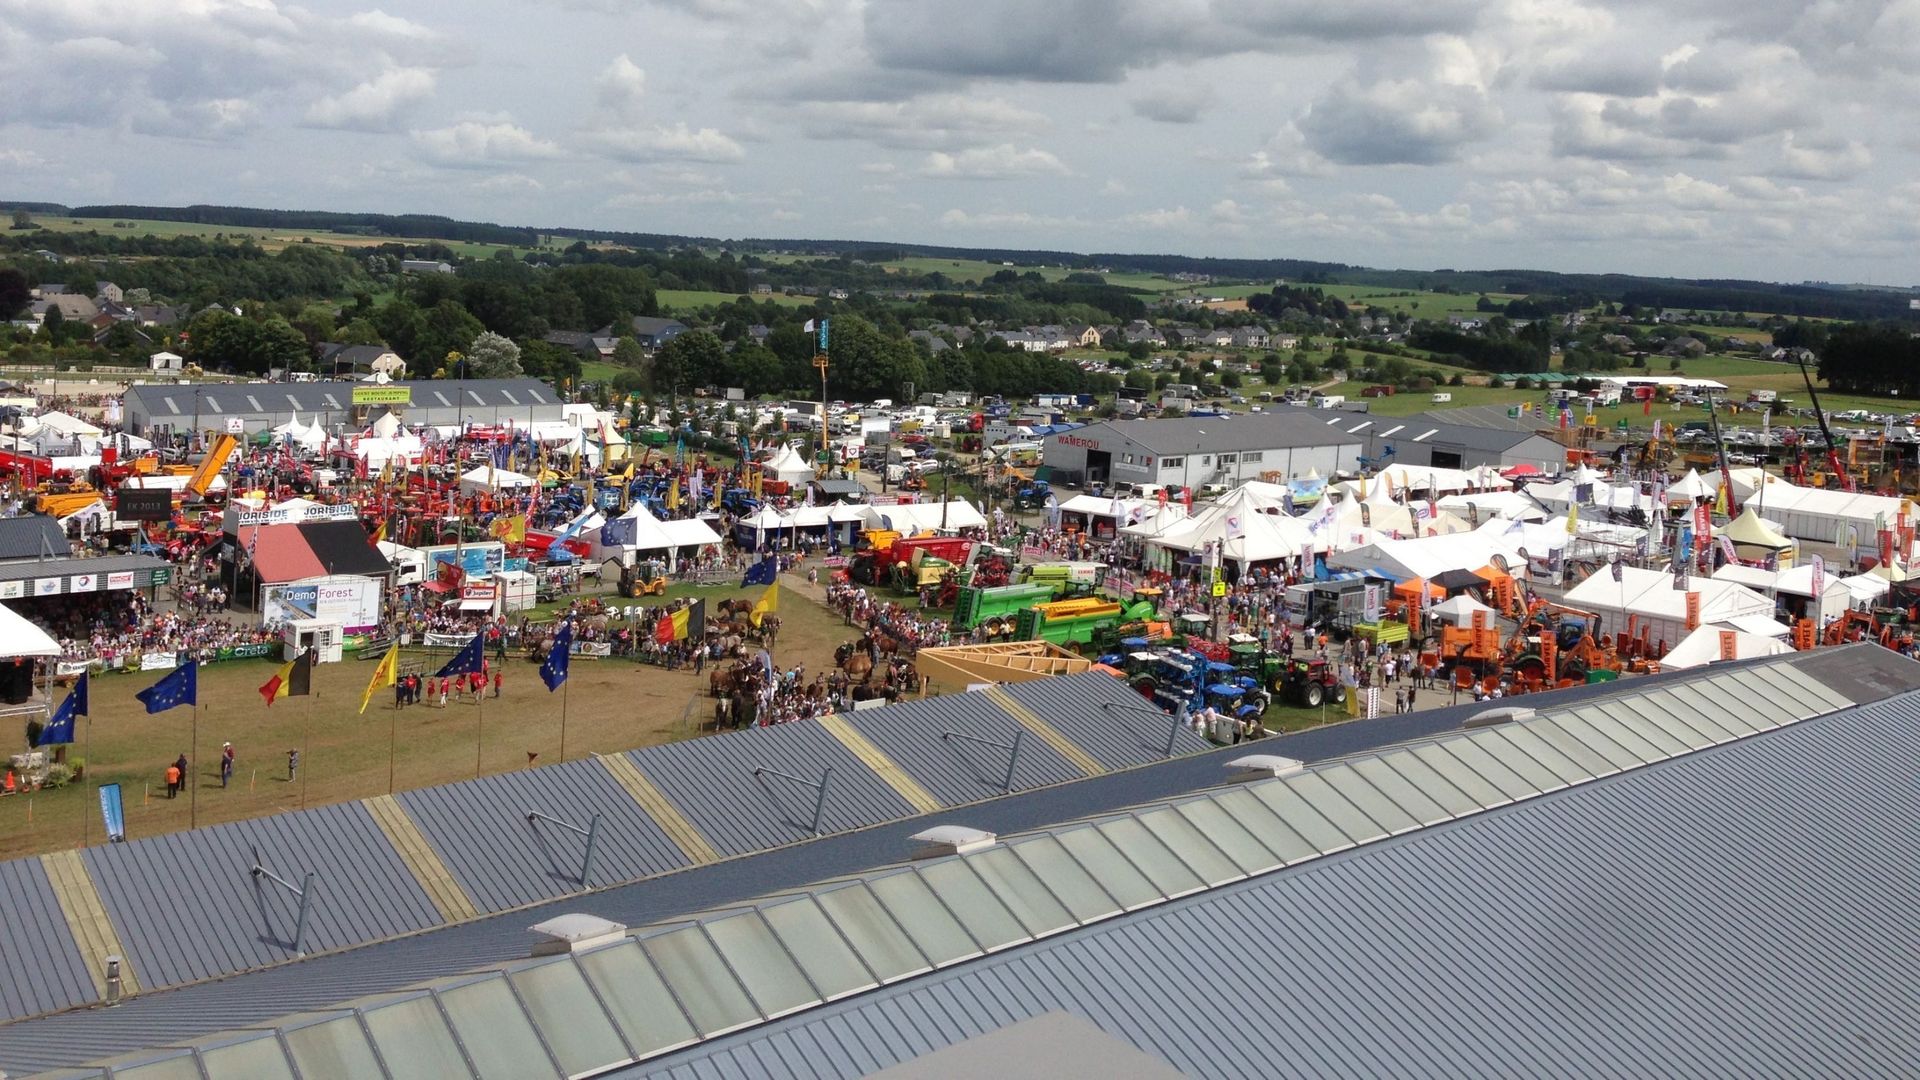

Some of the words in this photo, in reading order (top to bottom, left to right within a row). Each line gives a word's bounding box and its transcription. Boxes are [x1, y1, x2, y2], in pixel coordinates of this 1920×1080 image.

[1058, 435, 1100, 449] WAMEROU
[140, 502, 161, 510] 2013
[303, 504, 353, 516] JORISIDE
[239, 509, 288, 521] JORISIDE
[286, 590, 317, 601] Demo
[319, 588, 353, 599] Forest
[234, 645, 268, 657] Creta
